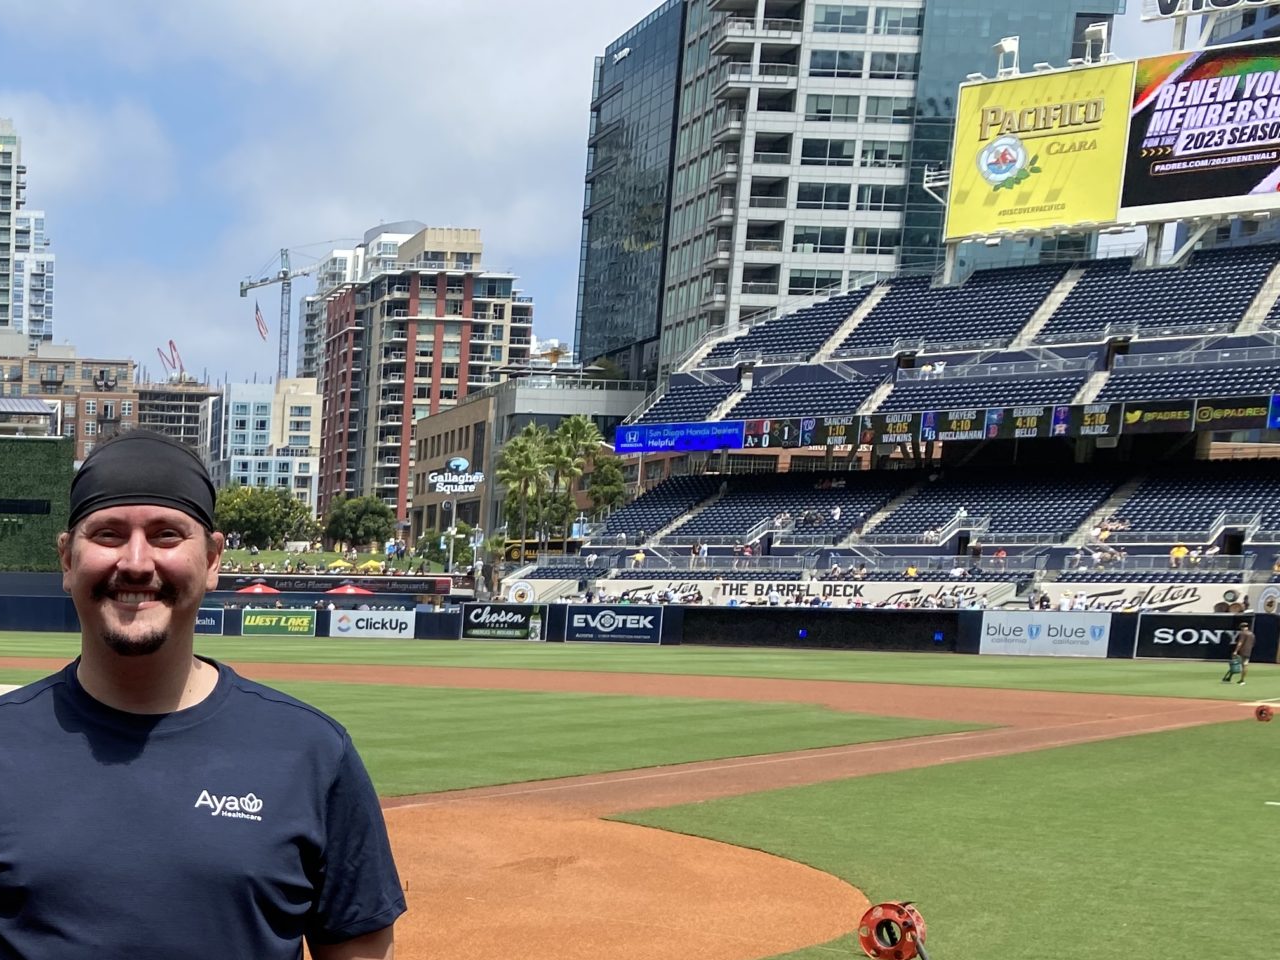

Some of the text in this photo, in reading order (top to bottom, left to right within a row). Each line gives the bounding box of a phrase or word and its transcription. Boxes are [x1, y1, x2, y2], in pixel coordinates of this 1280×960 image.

[1154, 75, 1241, 110] RENEW
[1182, 128, 1227, 152] 2023
[1227, 121, 1280, 145] SEASO
[1046, 139, 1098, 155] CLARA
[1154, 151, 1277, 172] PADRES.COM/2023RENEWALS
[997, 203, 1066, 217] #DISCOVERPACIFICO
[948, 410, 977, 420] MAYERS
[1083, 404, 1111, 414] BUNDY
[1213, 407, 1268, 419] @PADRES
[824, 416, 853, 427] SANCHEZ
[885, 413, 912, 423] GIOLITO
[1083, 413, 1107, 425] 5:10
[1143, 410, 1190, 422] @PADRES
[763, 420, 770, 433] 0
[886, 422, 909, 433] 4:05
[950, 420, 971, 431] 4:10
[1015, 417, 1037, 428] 4:10
[648, 426, 739, 438] San Diego Honda Dealers
[783, 426, 789, 440] 1
[828, 425, 846, 436] 1:10
[1014, 427, 1038, 438] BELLO
[1080, 424, 1110, 435] VALDEZ
[648, 438, 675, 448] Helpful
[762, 434, 770, 447] 0
[826, 435, 847, 445] KIRBY
[882, 432, 913, 443] WATKINS
[428, 472, 485, 484] Gallagher
[435, 482, 476, 494] Square
[294, 580, 306, 589] Go
[721, 583, 748, 596] THE
[823, 584, 864, 598] DECK
[469, 605, 526, 623] Chosen
[244, 615, 311, 626] WEST LAKE
[355, 617, 409, 633] ClickUp
[573, 610, 655, 632] EVOTEK
[986, 622, 1086, 638] blue blue
[991, 637, 1090, 646] california california
[1153, 628, 1240, 645] SONY
[194, 790, 240, 816] Aya
[221, 810, 262, 821] Healthcare
